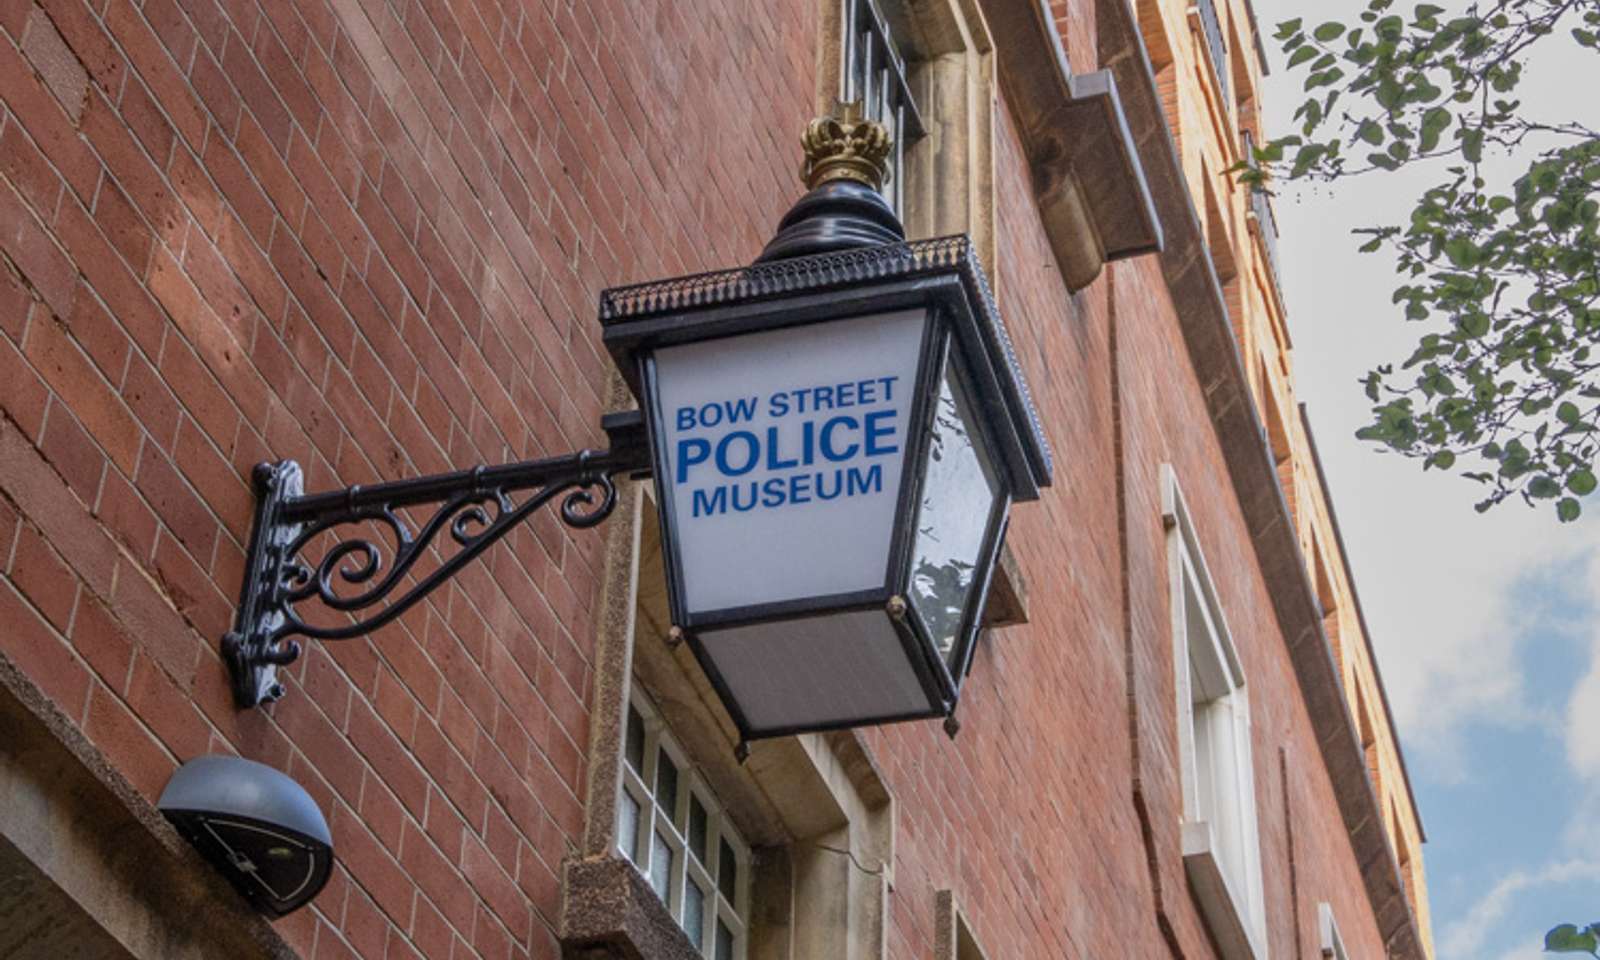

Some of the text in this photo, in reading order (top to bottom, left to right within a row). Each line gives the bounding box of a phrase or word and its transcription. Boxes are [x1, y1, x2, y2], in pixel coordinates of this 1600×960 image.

[676, 376, 898, 432] BOW STREET
[676, 409, 899, 484] POLICE
[692, 464, 882, 518] MUSEUM
